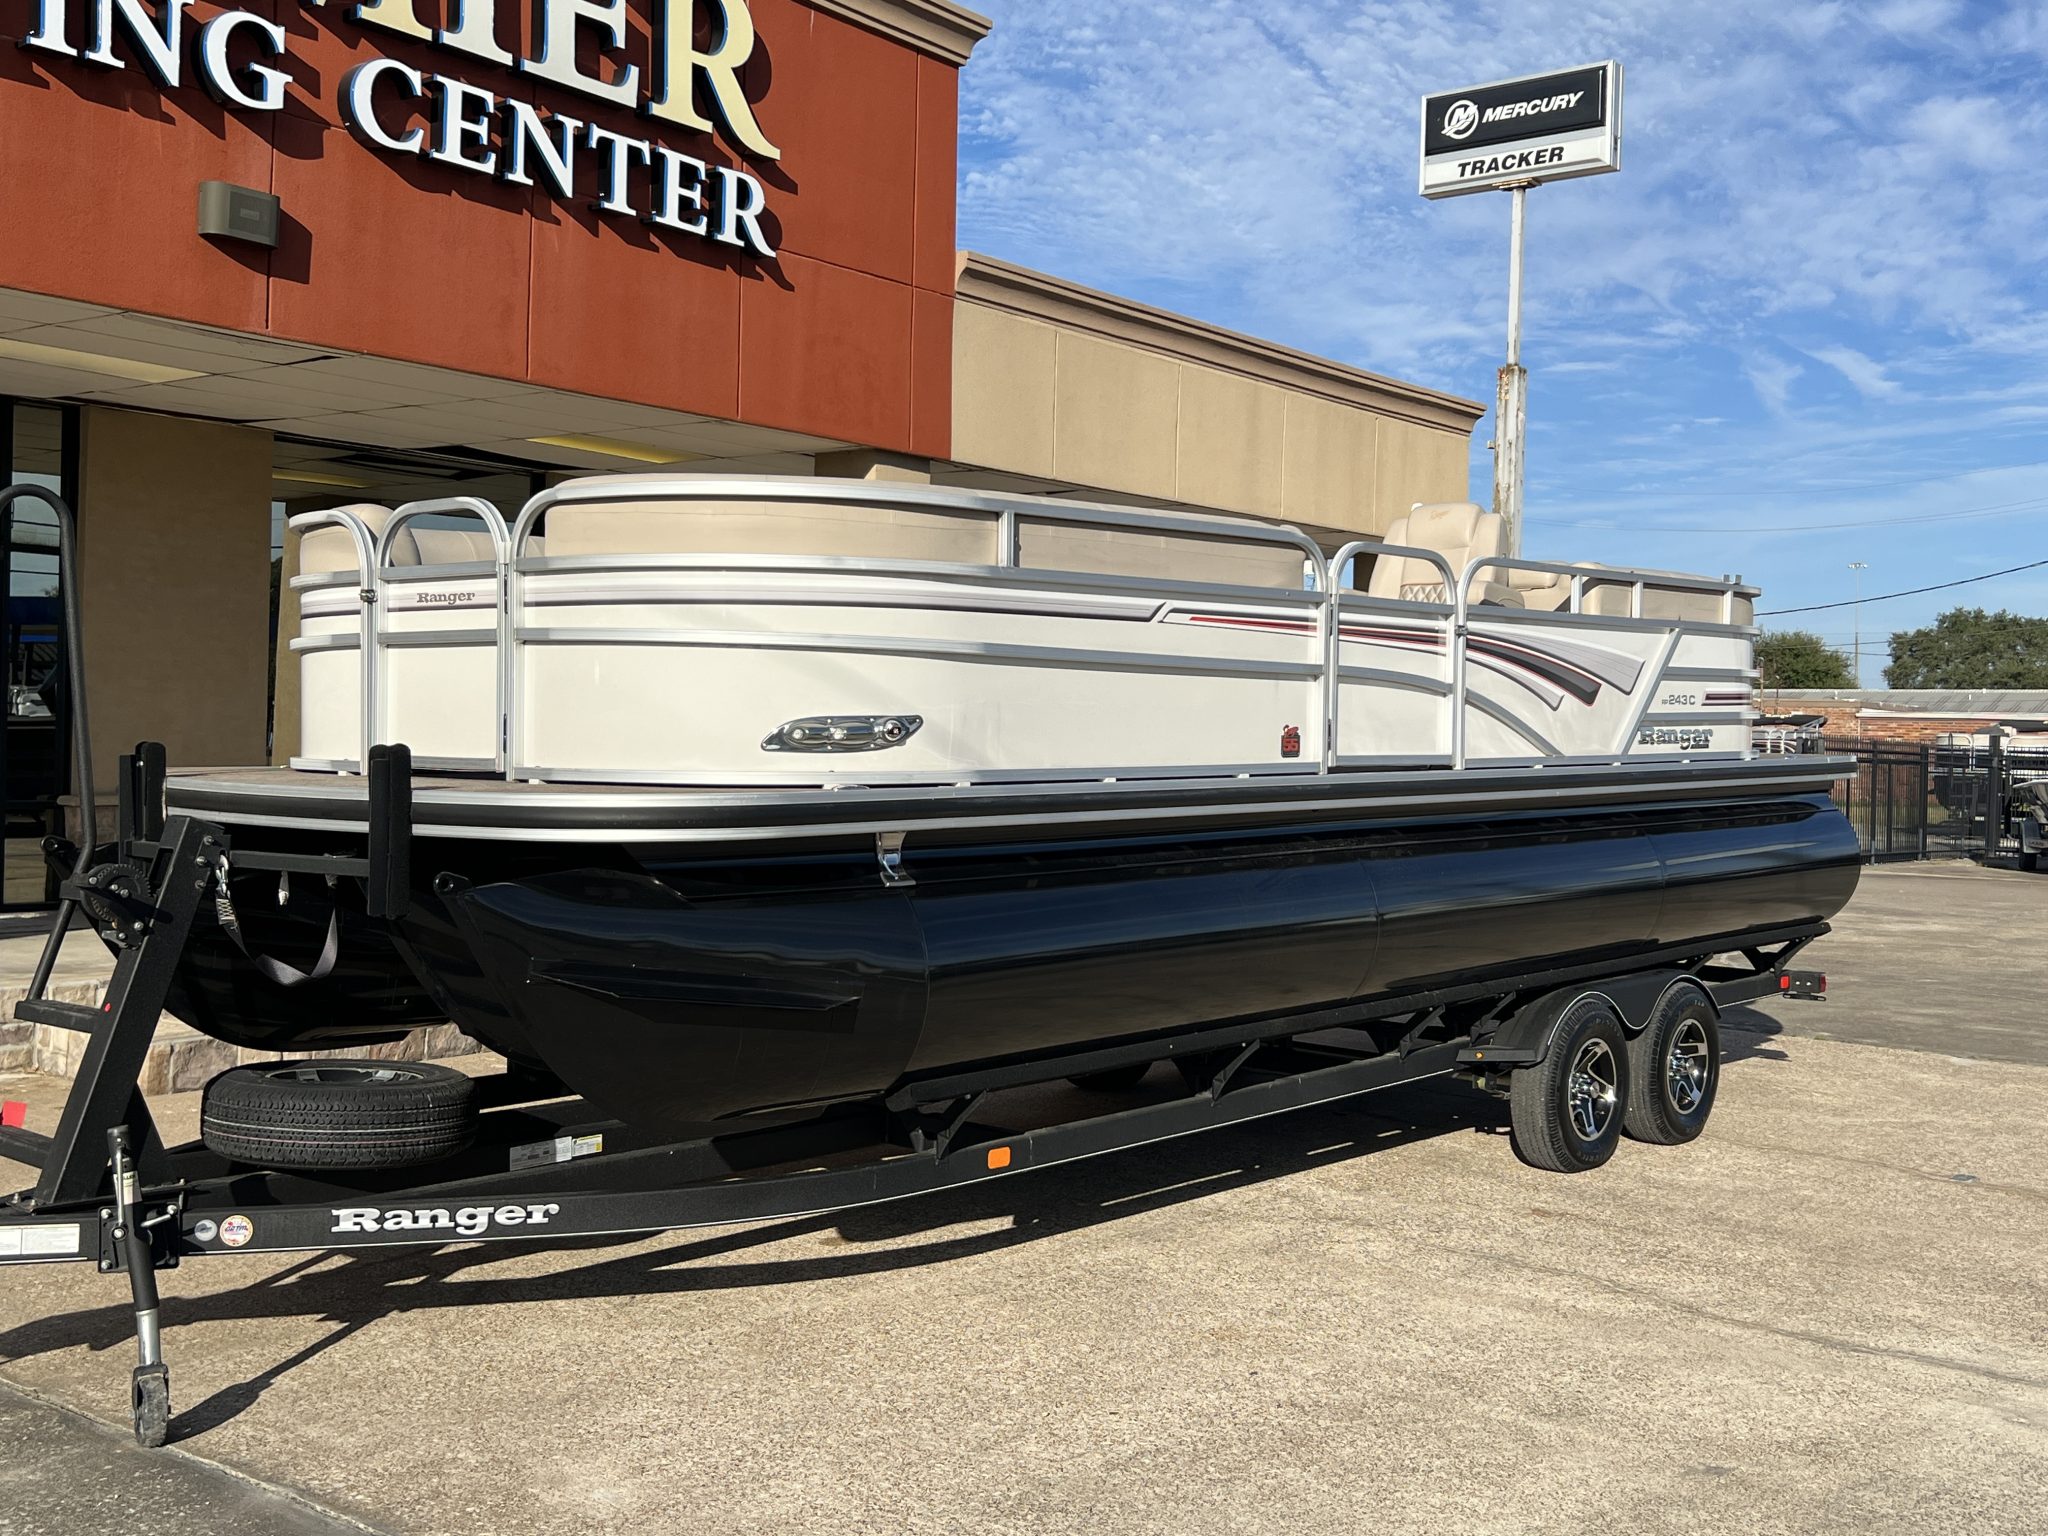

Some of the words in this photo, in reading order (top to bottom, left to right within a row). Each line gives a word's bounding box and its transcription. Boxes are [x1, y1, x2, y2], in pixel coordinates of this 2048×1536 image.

[1481, 90, 1585, 124] MERCURY
[348, 58, 777, 258] CENTER
[1457, 146, 1565, 178] TRACKER
[416, 592, 476, 605] Ranger
[1638, 727, 1714, 750] Ranger
[330, 1203, 561, 1236] Ranger
